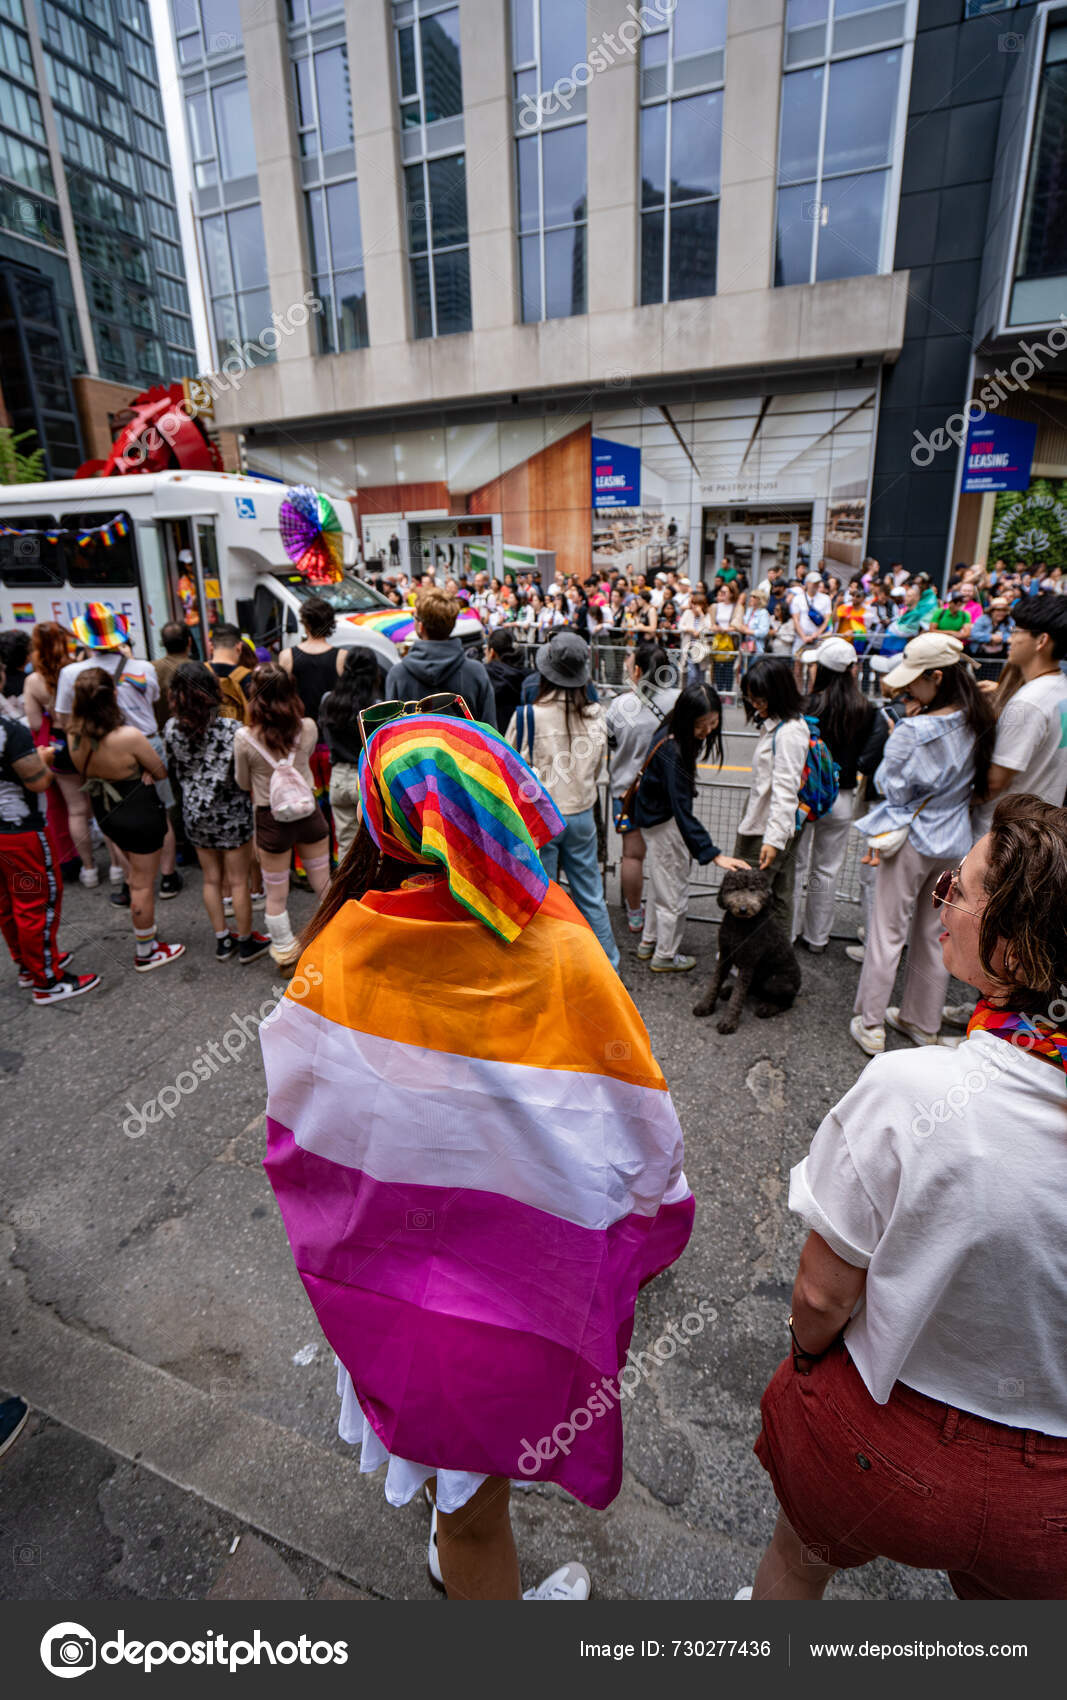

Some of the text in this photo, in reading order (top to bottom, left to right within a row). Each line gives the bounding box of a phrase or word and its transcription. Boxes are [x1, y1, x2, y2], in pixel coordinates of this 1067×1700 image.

[968, 453, 1010, 469] LEASING
[596, 475, 626, 489] LEASING
[992, 503, 1023, 543] MIND
[1026, 495, 1055, 510] AND
